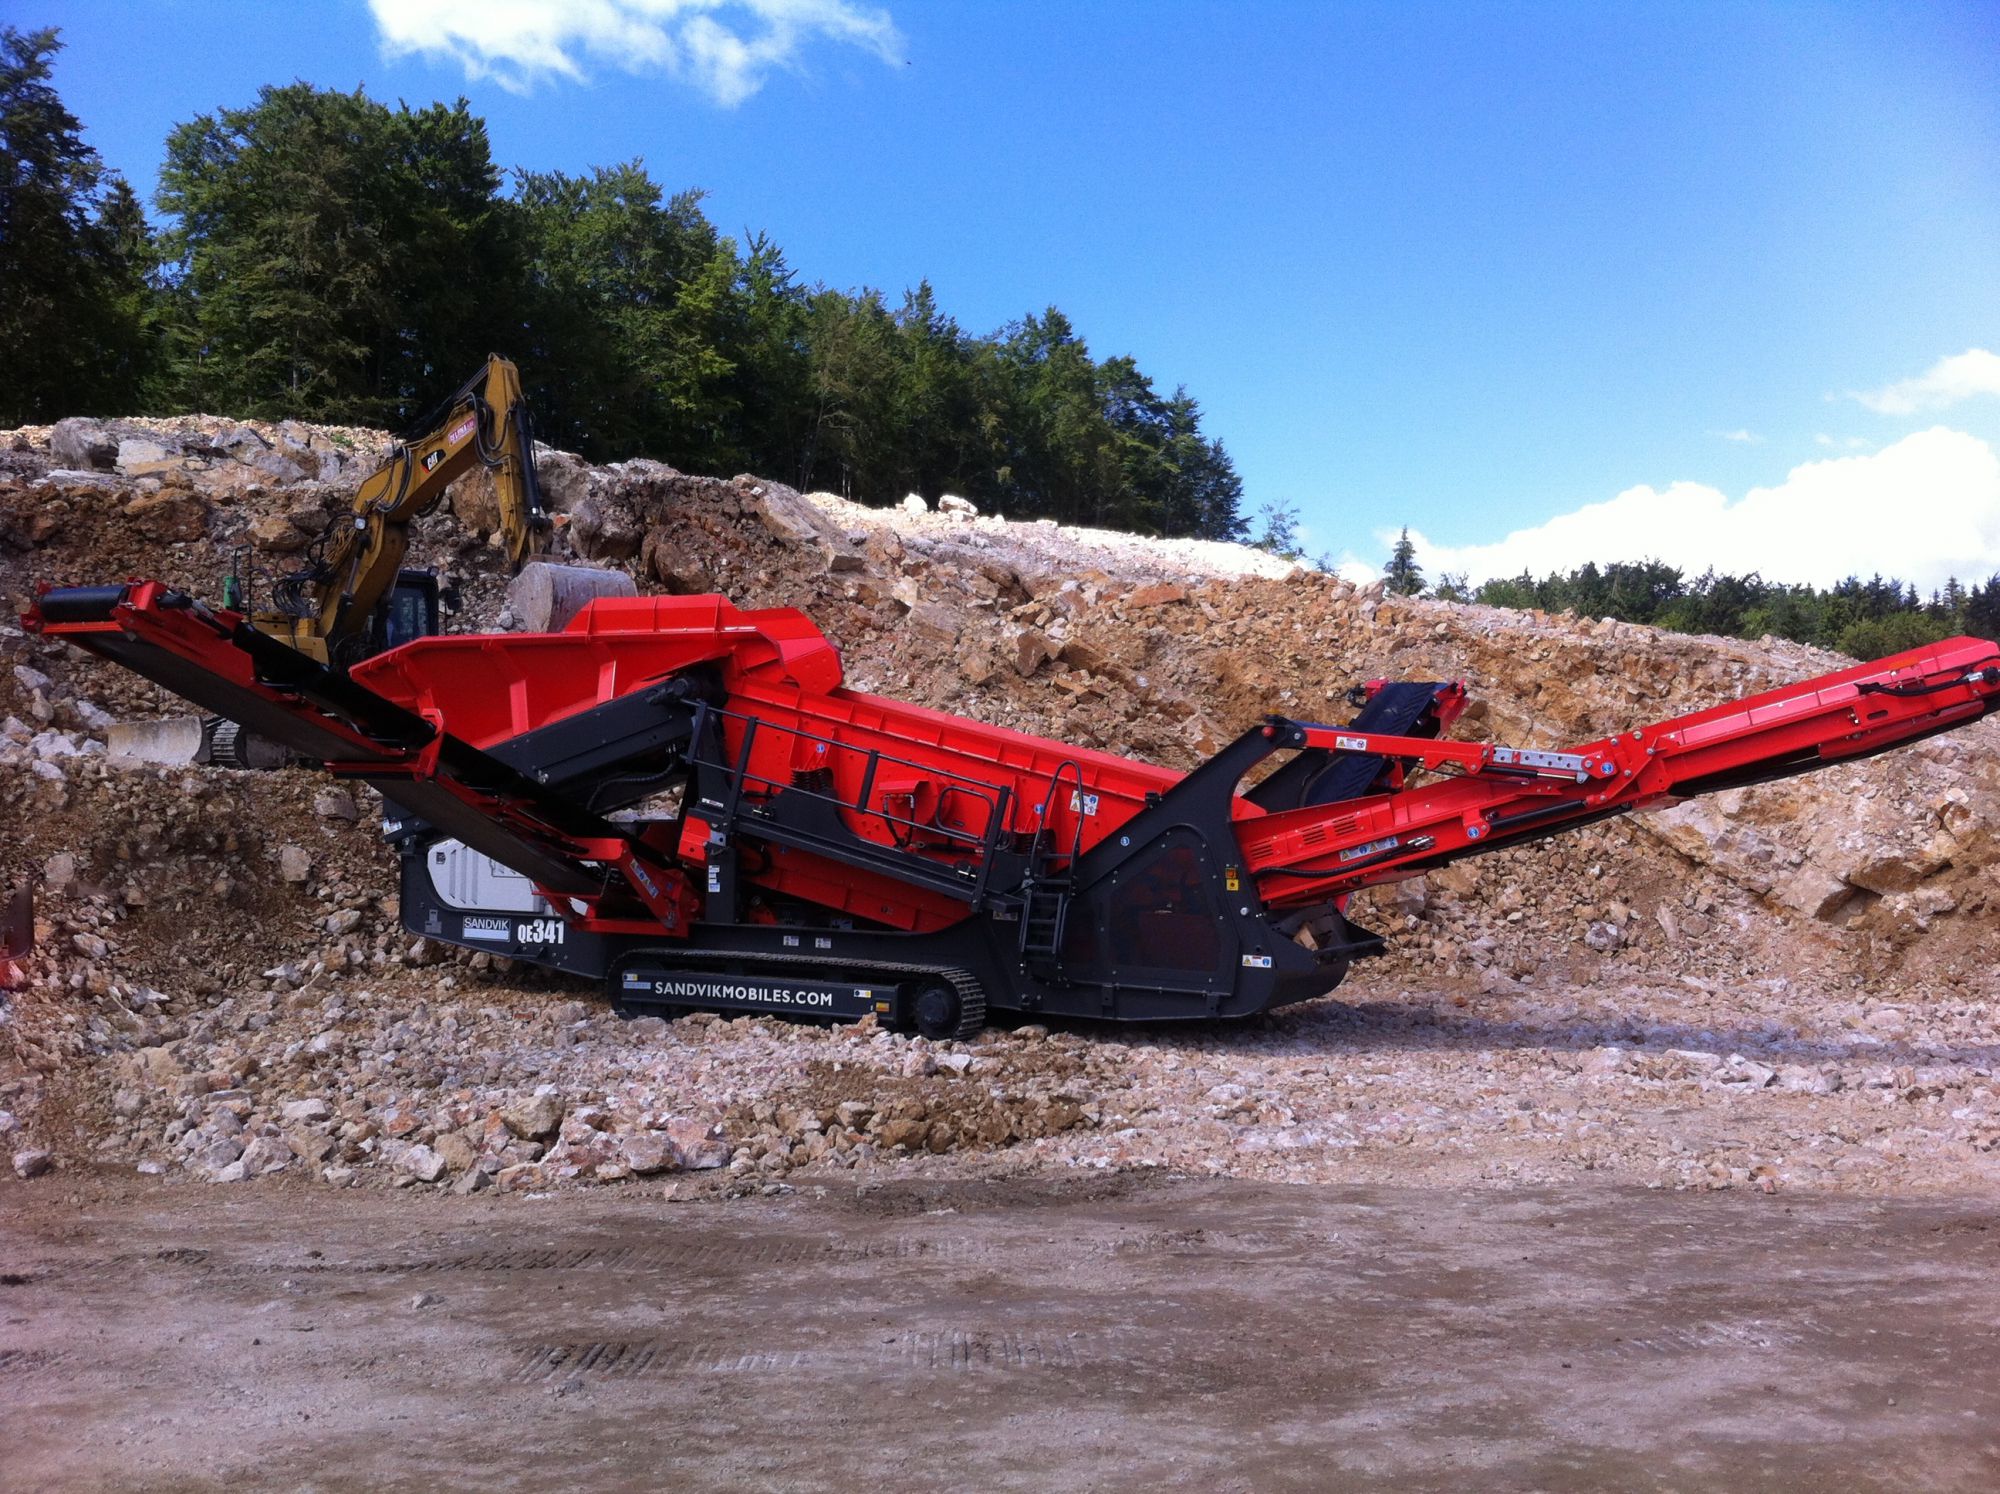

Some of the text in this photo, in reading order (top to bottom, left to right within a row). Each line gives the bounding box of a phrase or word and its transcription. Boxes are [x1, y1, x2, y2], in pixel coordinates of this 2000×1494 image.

[427, 451, 438, 470] CAT
[464, 917, 509, 930] SANDVIK
[517, 919, 565, 944] QE341
[654, 981, 832, 1006] SANDVIKMOBILES.COM
